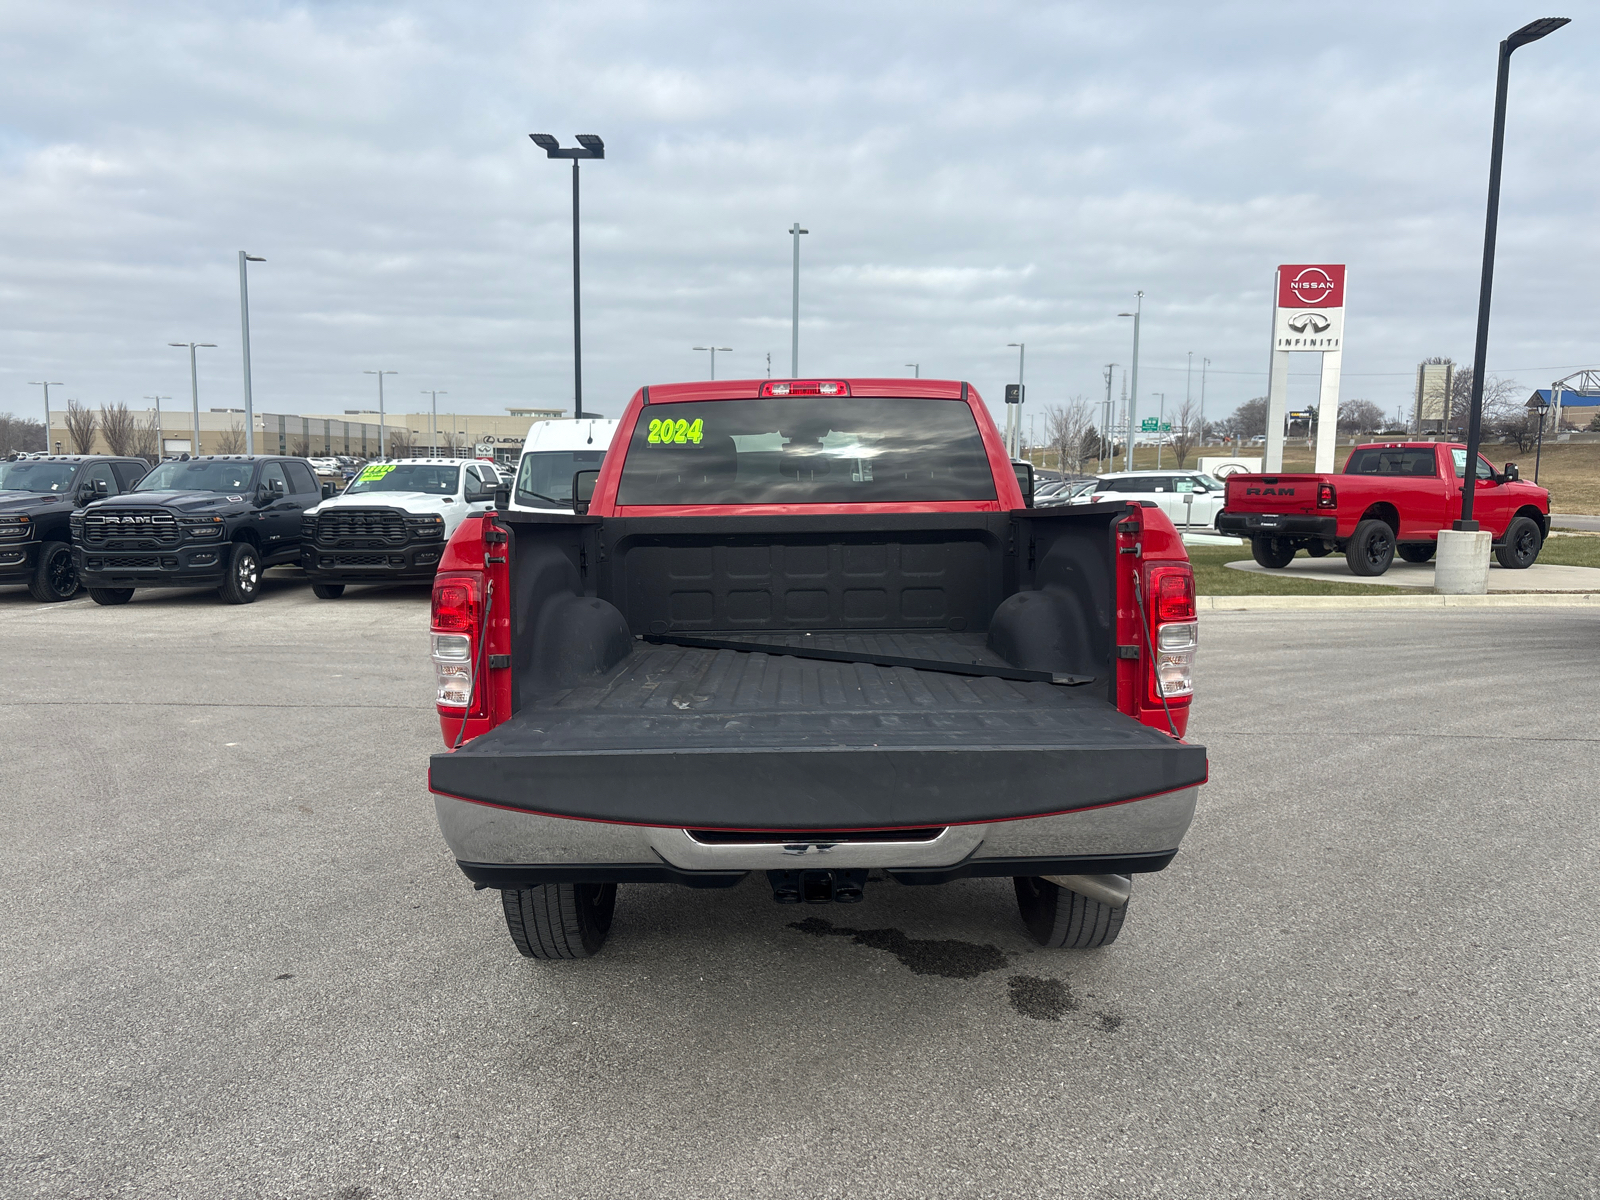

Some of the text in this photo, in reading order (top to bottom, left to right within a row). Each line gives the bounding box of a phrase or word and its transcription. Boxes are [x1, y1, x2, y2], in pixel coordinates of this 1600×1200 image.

[1278, 338, 1339, 347] INFINITI
[647, 418, 704, 444] 2024
[1246, 488, 1295, 496] RAM
[105, 516, 151, 524] RAM
